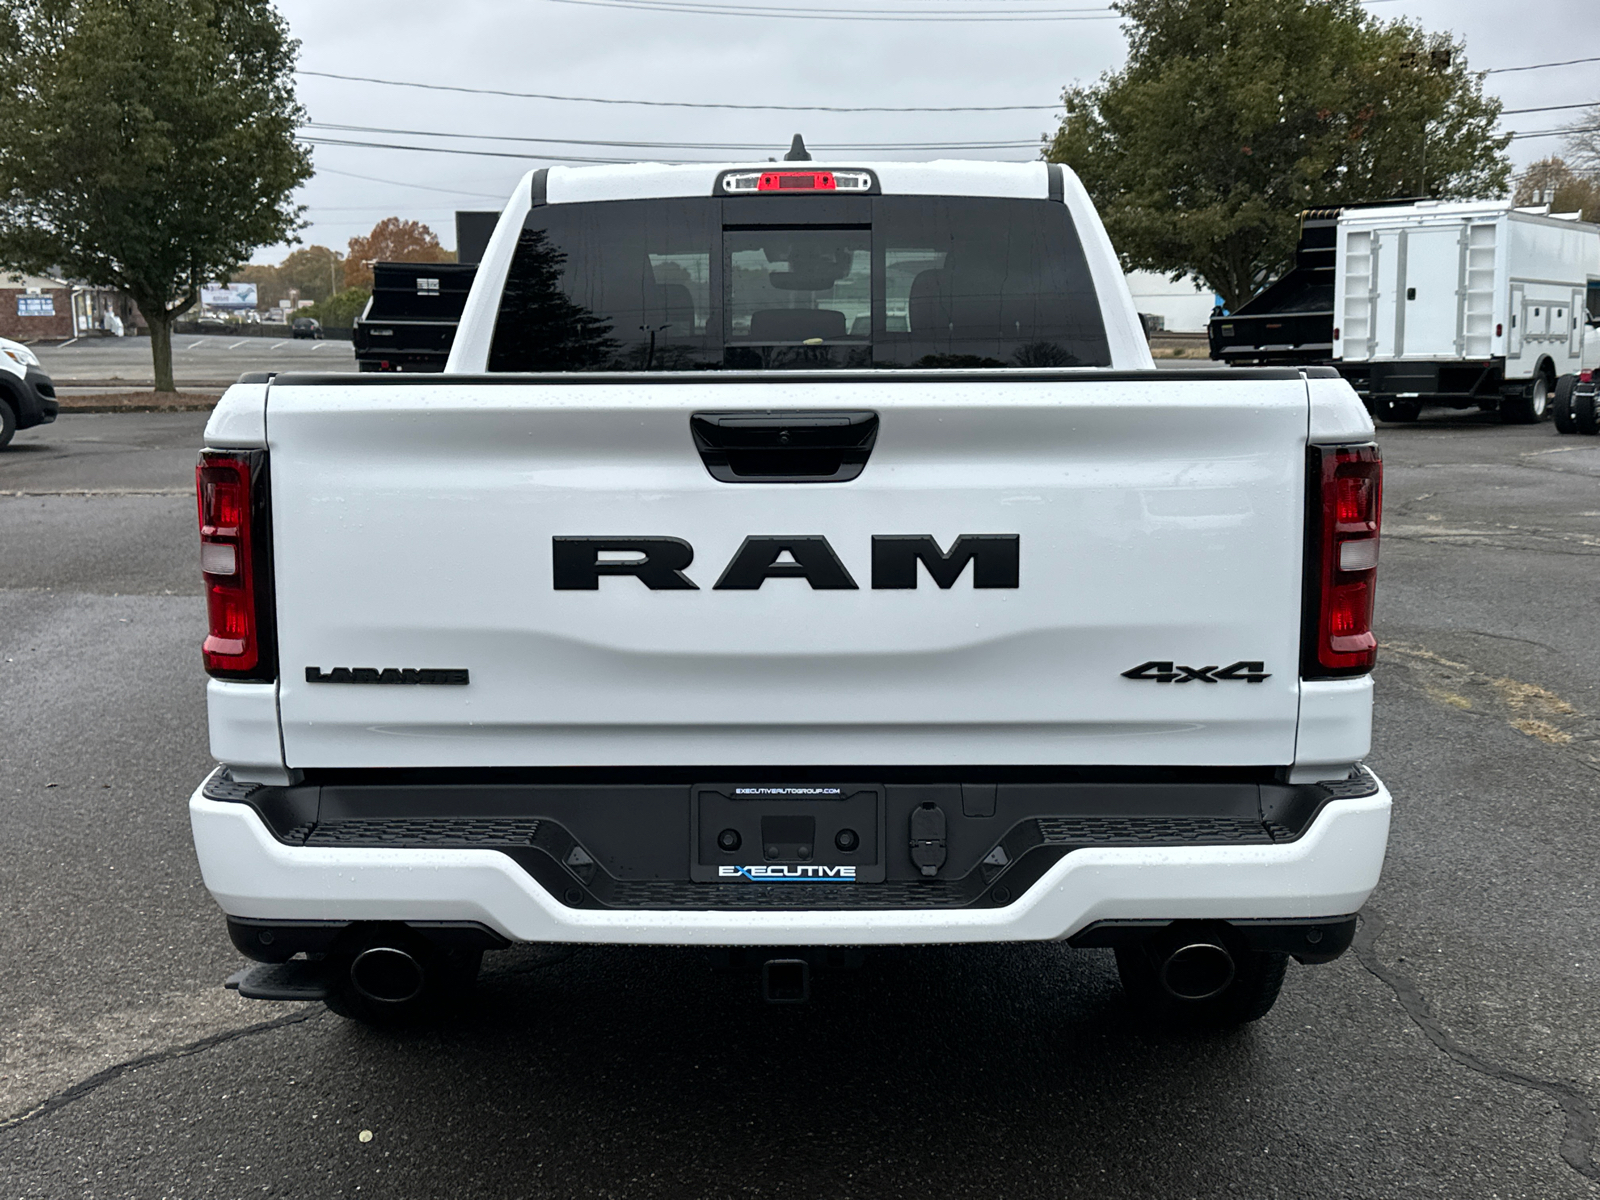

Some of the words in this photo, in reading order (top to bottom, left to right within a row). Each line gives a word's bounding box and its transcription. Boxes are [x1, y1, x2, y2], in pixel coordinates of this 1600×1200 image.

[552, 533, 1020, 591] RAM
[1120, 661, 1273, 683] 4x4
[718, 865, 857, 879] EXECUTIVE
